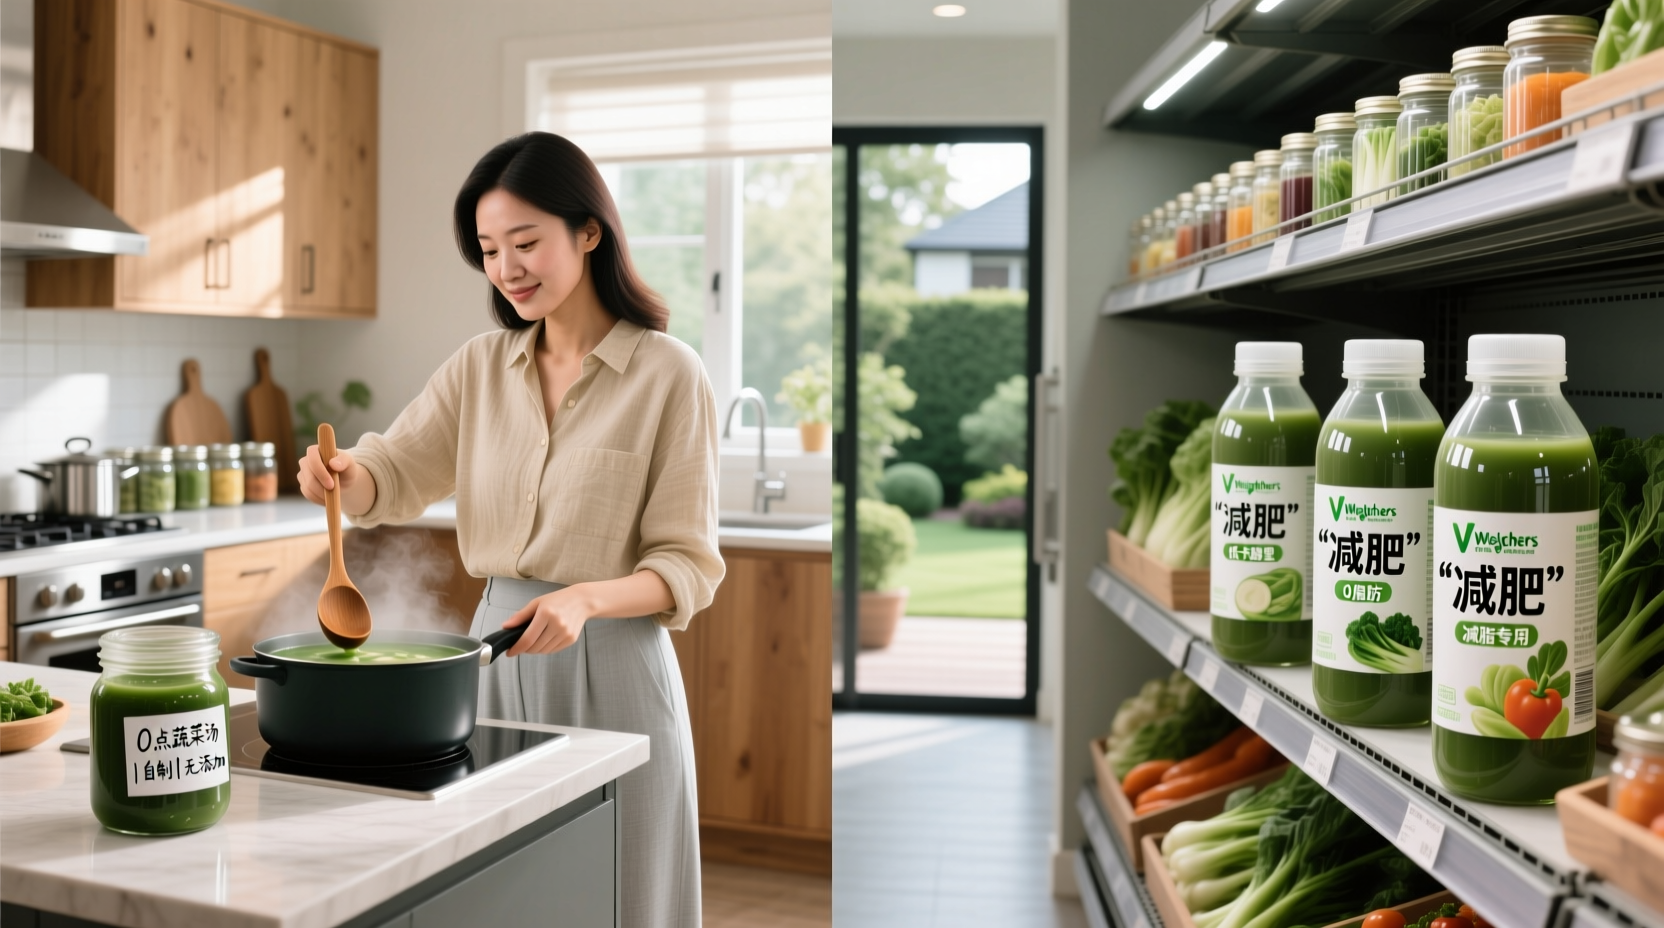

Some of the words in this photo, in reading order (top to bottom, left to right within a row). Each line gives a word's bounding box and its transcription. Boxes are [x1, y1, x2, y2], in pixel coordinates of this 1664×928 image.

[1215, 501, 1299, 539] “减肥”
[1319, 528, 1421, 576] “减肥”
[1439, 561, 1564, 616] “减肥”
